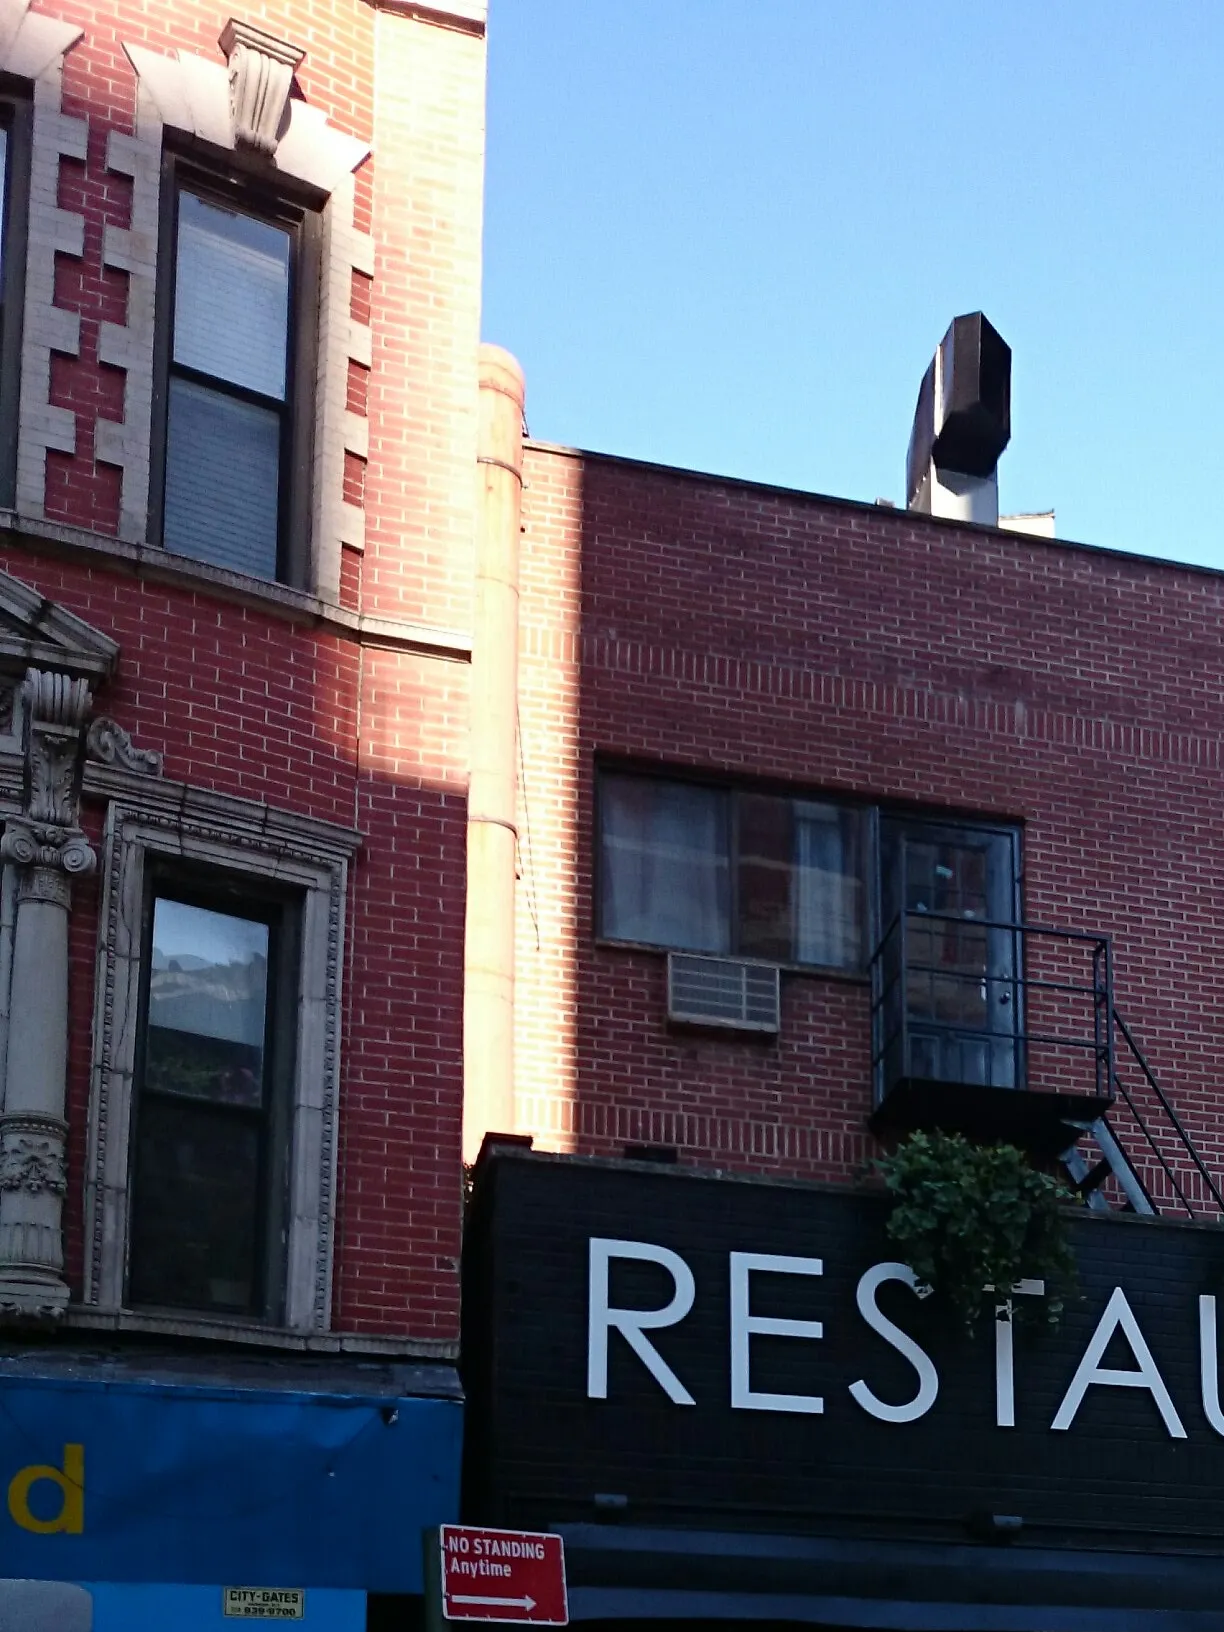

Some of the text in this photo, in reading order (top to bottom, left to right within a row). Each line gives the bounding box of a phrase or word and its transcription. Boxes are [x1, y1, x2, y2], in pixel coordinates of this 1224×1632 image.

[448, 1536, 545, 1560] NO STANDING
[451, 1557, 512, 1579] Anytime
[230, 1590, 299, 1604] CITY-GATES
